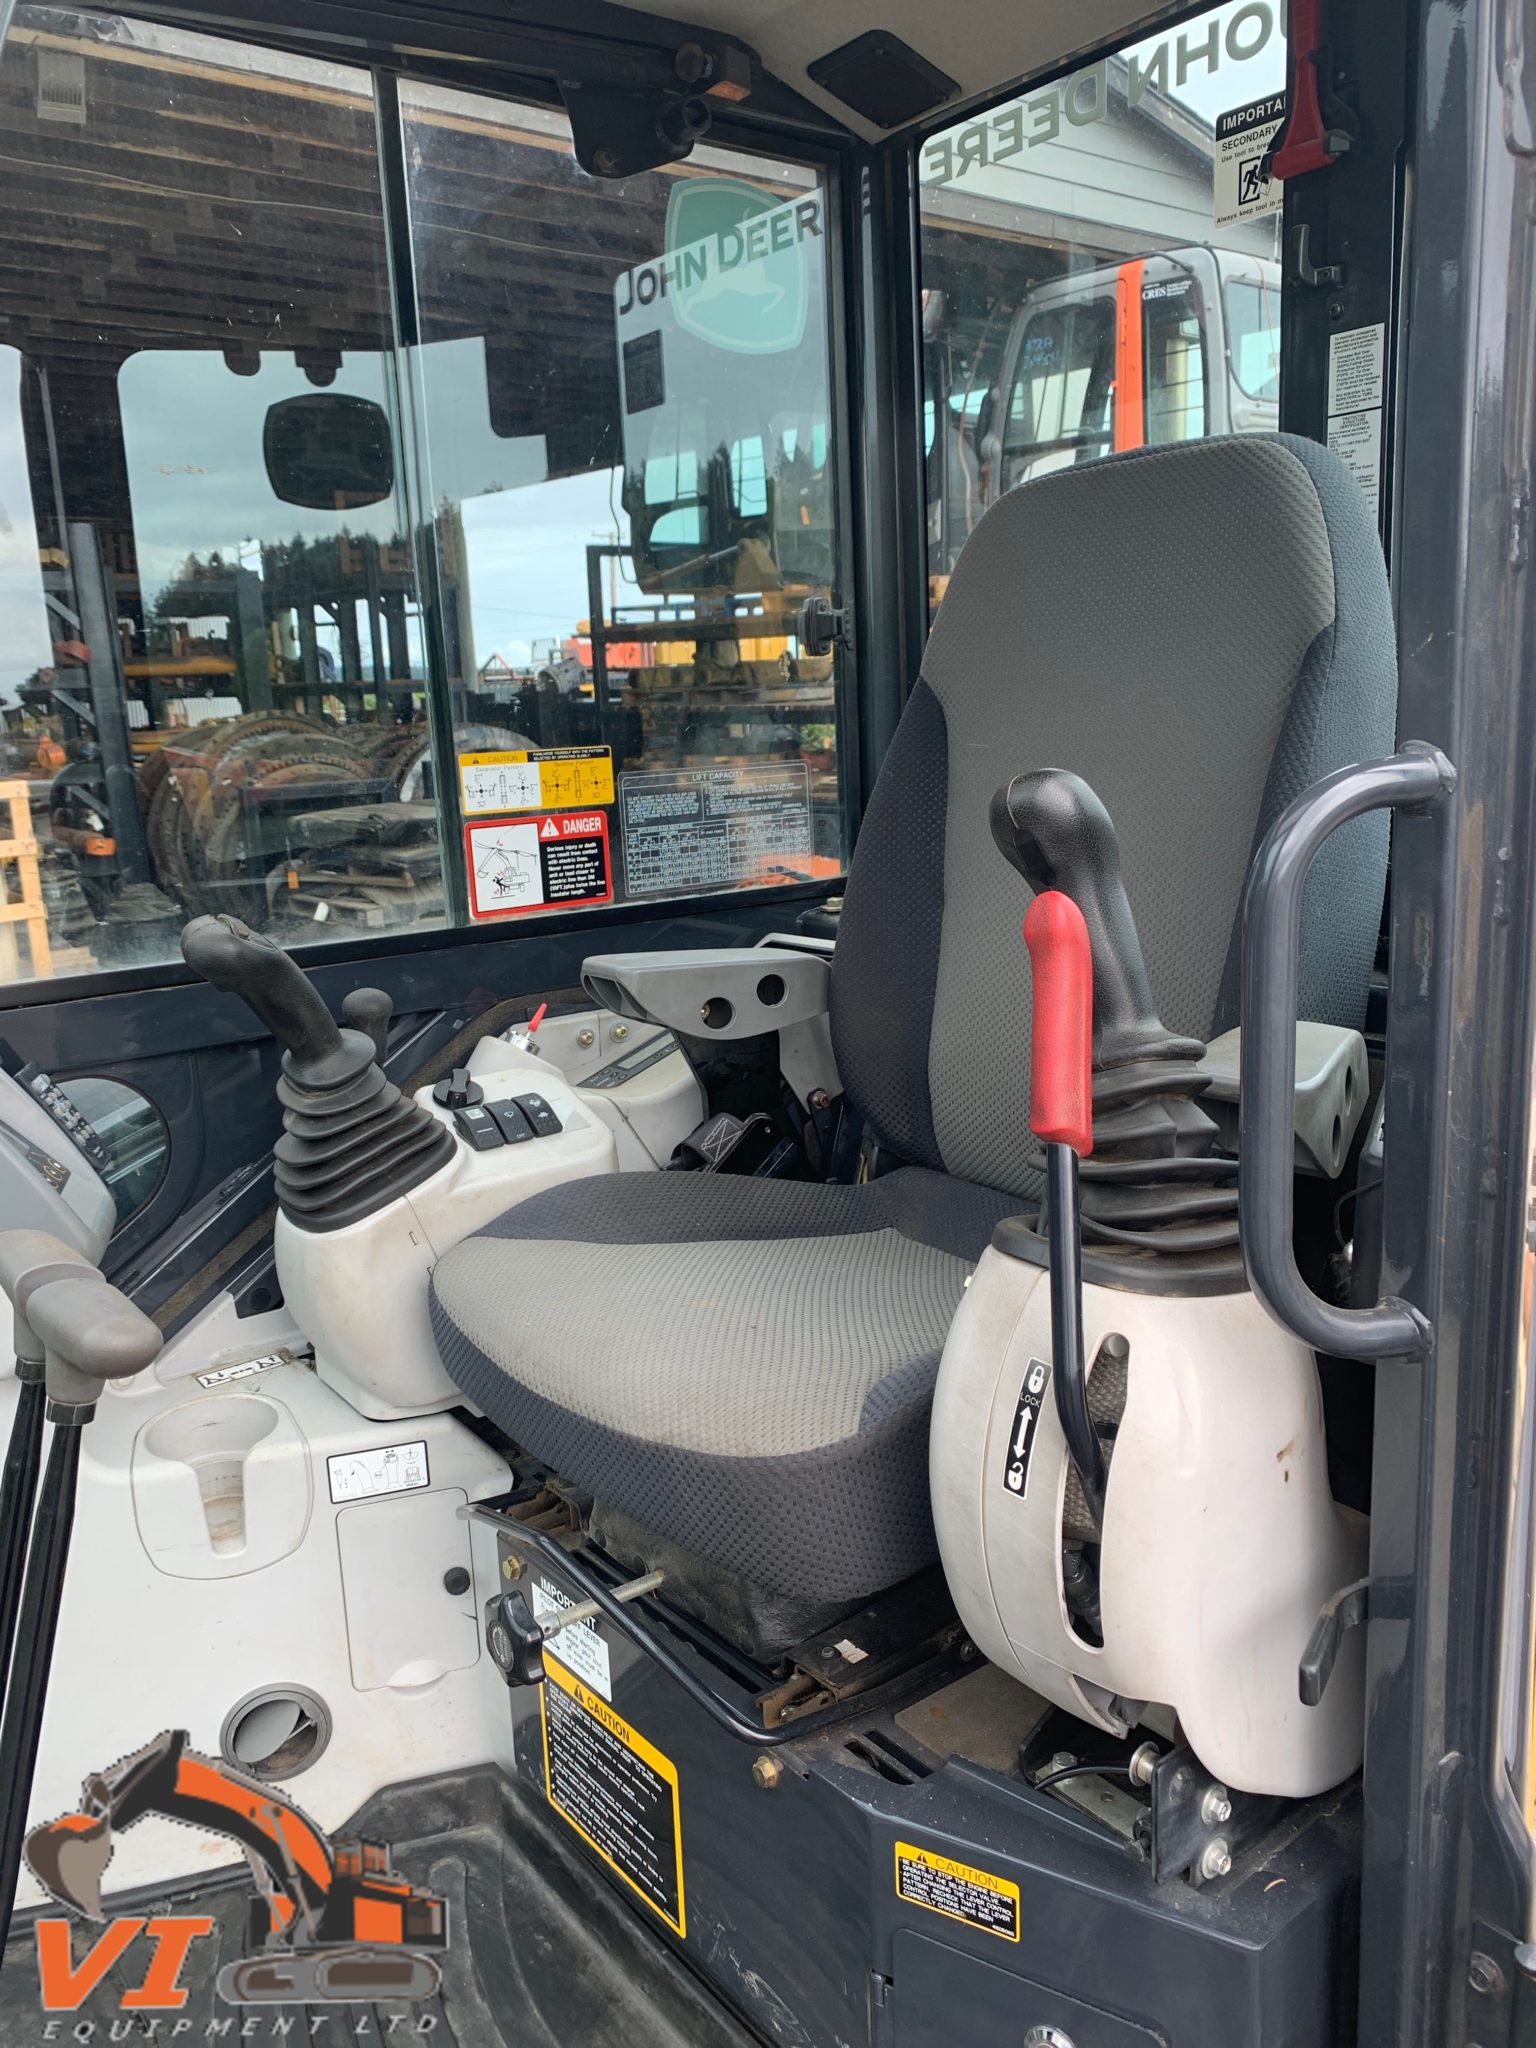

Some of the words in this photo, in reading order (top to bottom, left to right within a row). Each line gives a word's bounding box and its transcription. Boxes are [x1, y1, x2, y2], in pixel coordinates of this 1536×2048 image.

[1221, 124, 1278, 152] SECONDARY
[1221, 154, 1233, 163] Use
[1234, 149, 1247, 158] tool
[1216, 213, 1238, 224] Always
[1239, 207, 1254, 217] keep
[1255, 202, 1268, 211] tool
[619, 244, 708, 316] JOHN
[475, 765, 502, 773] Excavator
[503, 763, 524, 771] Pattern
[487, 755, 519, 763] CAUTION
[692, 772, 708, 782] LIFT
[709, 769, 745, 780] CAPACITY
[562, 816, 602, 835] DANGER
[1020, 1391, 1041, 1408] LOCK
[583, 1627, 600, 1646] LEVER
[587, 1697, 630, 1743] CAUTION
[902, 1858, 910, 1866] BE
[911, 1861, 926, 1872] SURE
[928, 1867, 936, 1876] TO
[938, 1871, 953, 1880] STOP
[954, 1876, 966, 1887] THE
[967, 1881, 989, 1895] ENGINE
[989, 1890, 1013, 1904] BEFORE
[902, 1864, 934, 1880] OPERATING
[935, 1875, 947, 1886] THE
[948, 1881, 978, 1898] SELECTOR
[935, 1858, 998, 1890] CAUTION
[902, 1870, 921, 1882] AFTER
[922, 1878, 952, 1894] CHANGING
[953, 1889, 965, 1899] THE
[965, 1894, 985, 1907] LEVER
[986, 1901, 1015, 1918] CONTROL
[902, 1889, 936, 1907] CORRECTLY
[902, 1883, 930, 1898] CONTROL
[930, 1893, 960, 1909] POSITIONS
[960, 1905, 977, 1916] HAVE
[977, 1911, 994, 1923] BEEN
[932, 1888, 959, 1903] RECHECK
[960, 1898, 977, 1909] THAT
[977, 1904, 990, 1915] THE
[991, 1910, 1011, 1923] LEVER
